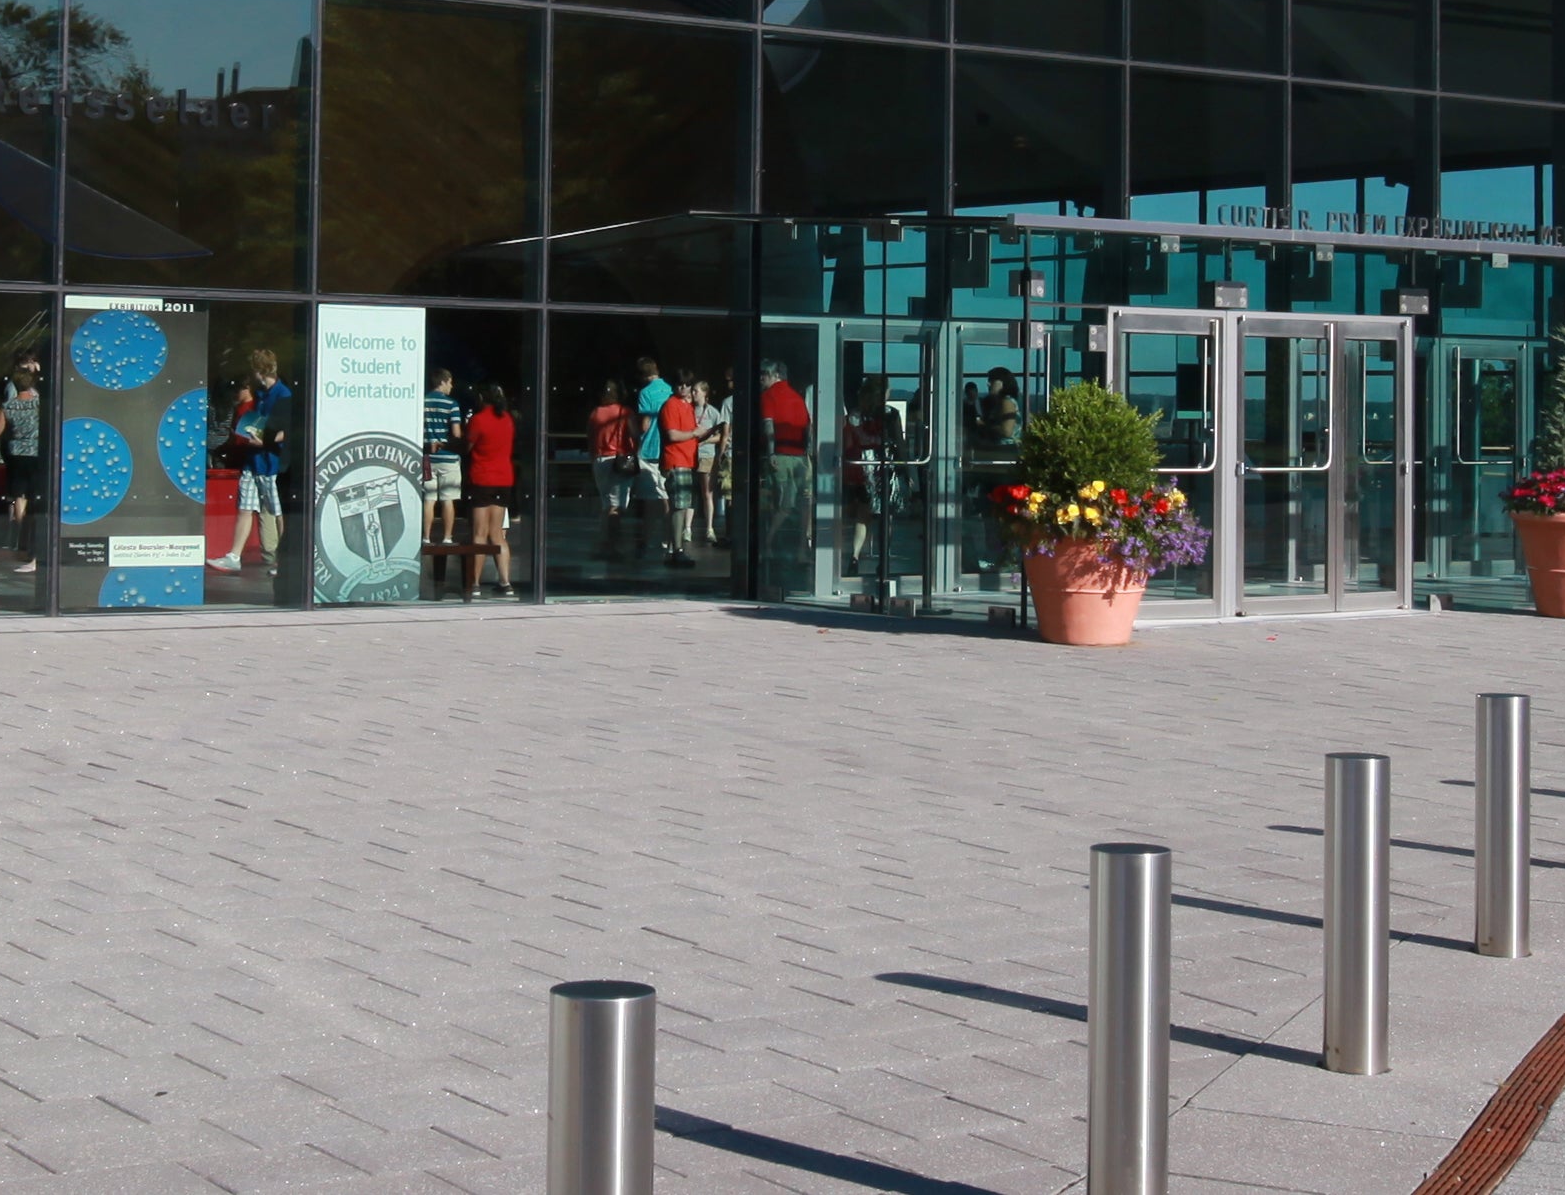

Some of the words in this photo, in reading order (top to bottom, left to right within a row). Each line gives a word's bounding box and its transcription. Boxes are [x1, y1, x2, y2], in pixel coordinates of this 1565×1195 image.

[1218, 204, 1291, 230] CURTIS
[1298, 210, 1313, 231] R.
[1326, 211, 1387, 235] PRIEM
[1395, 216, 1531, 243] EXPERIMENTAL
[164, 302, 195, 313] 2011
[325, 332, 395, 351] Welcome
[401, 336, 418, 352] to
[340, 356, 402, 375] Student
[324, 381, 416, 400] Orientation!
[320, 443, 422, 486] POLYTECHNIC
